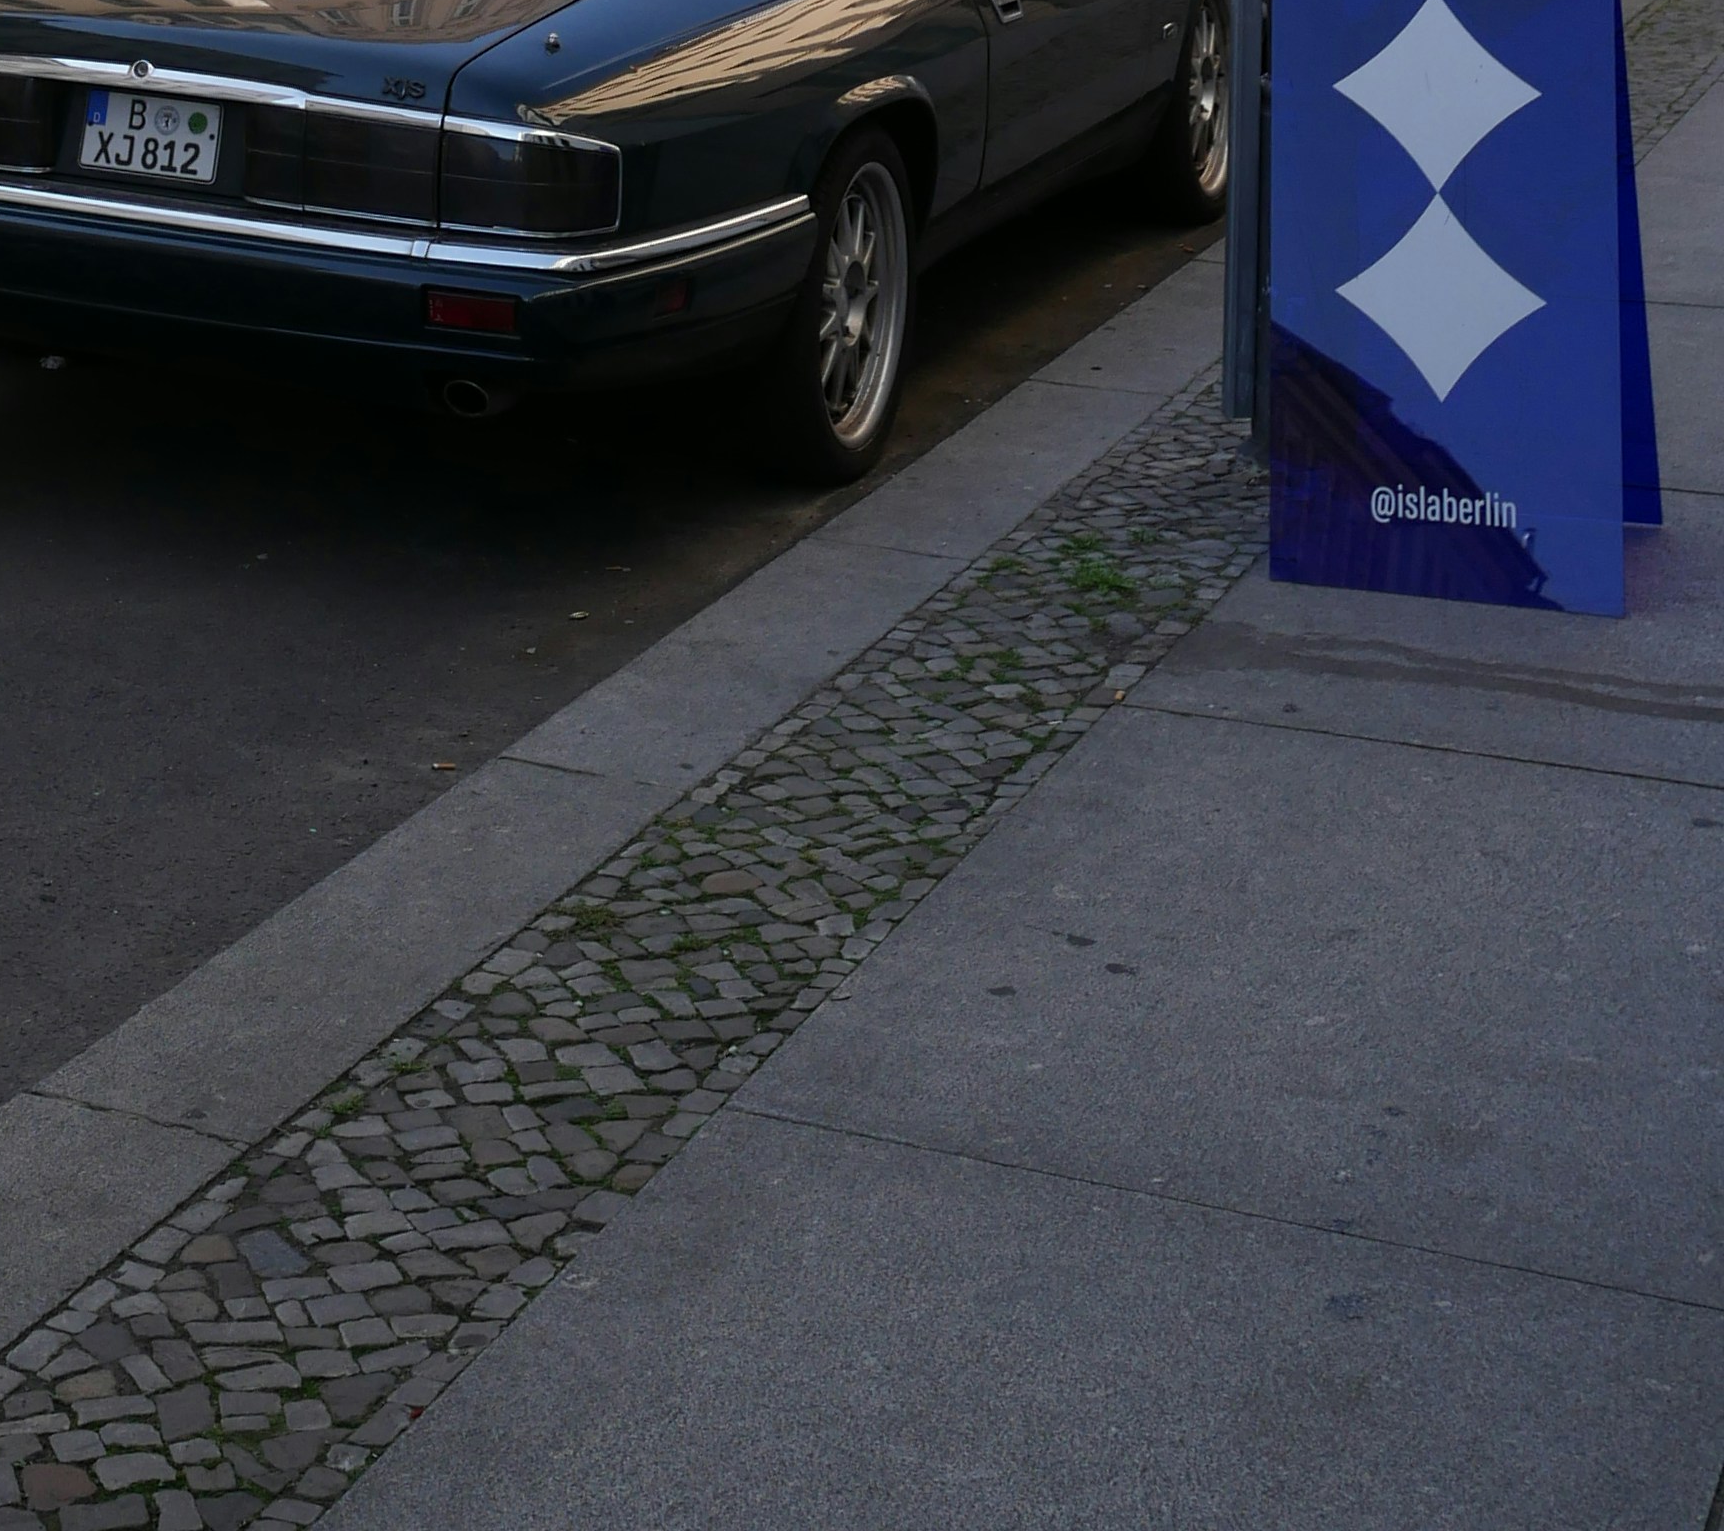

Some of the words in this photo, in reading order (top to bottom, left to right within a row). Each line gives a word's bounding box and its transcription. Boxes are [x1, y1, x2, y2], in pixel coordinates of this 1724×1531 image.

[382, 76, 426, 99] XJS
[92, 111, 101, 123] D
[128, 98, 148, 130] B
[1370, 483, 1517, 529] @islaberlin
